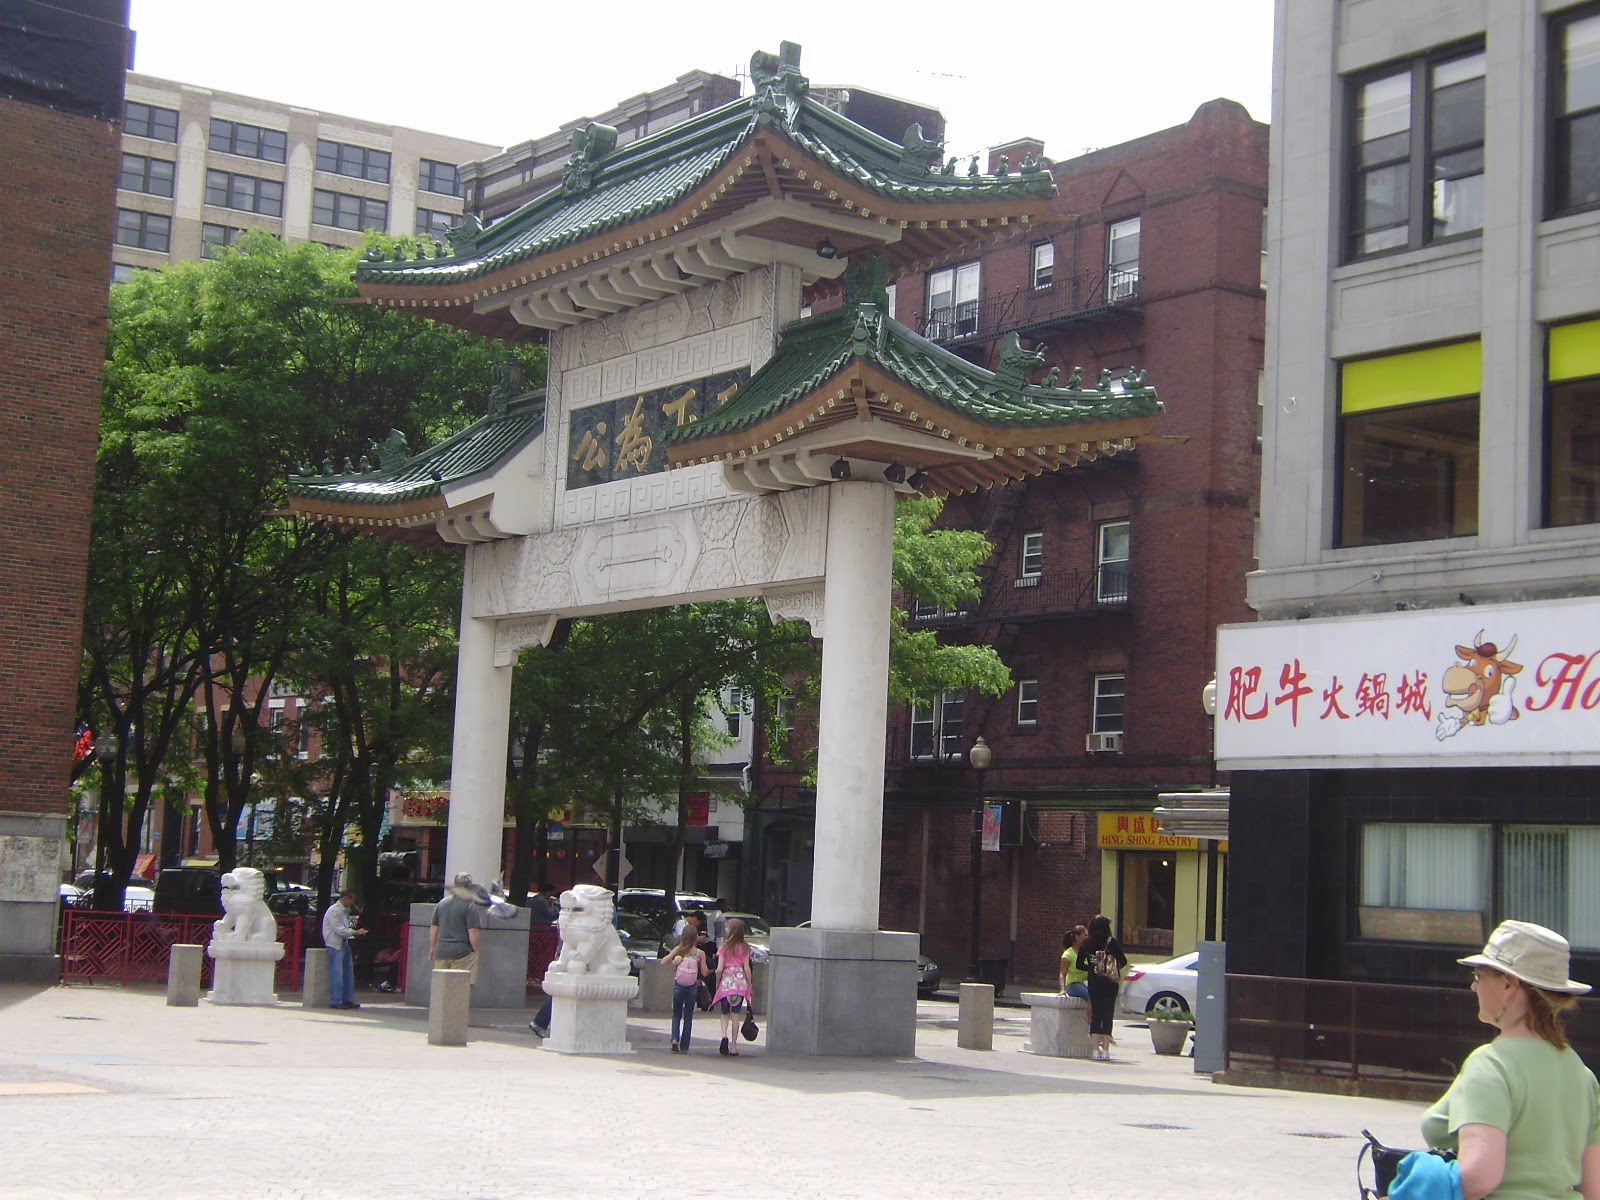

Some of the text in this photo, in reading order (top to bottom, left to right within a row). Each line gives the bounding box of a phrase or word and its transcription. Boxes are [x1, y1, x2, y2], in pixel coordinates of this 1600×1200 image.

[1224, 658, 1432, 728] 肥牛火鍋城
[1102, 835, 1194, 847] HING SHING PASTRY
